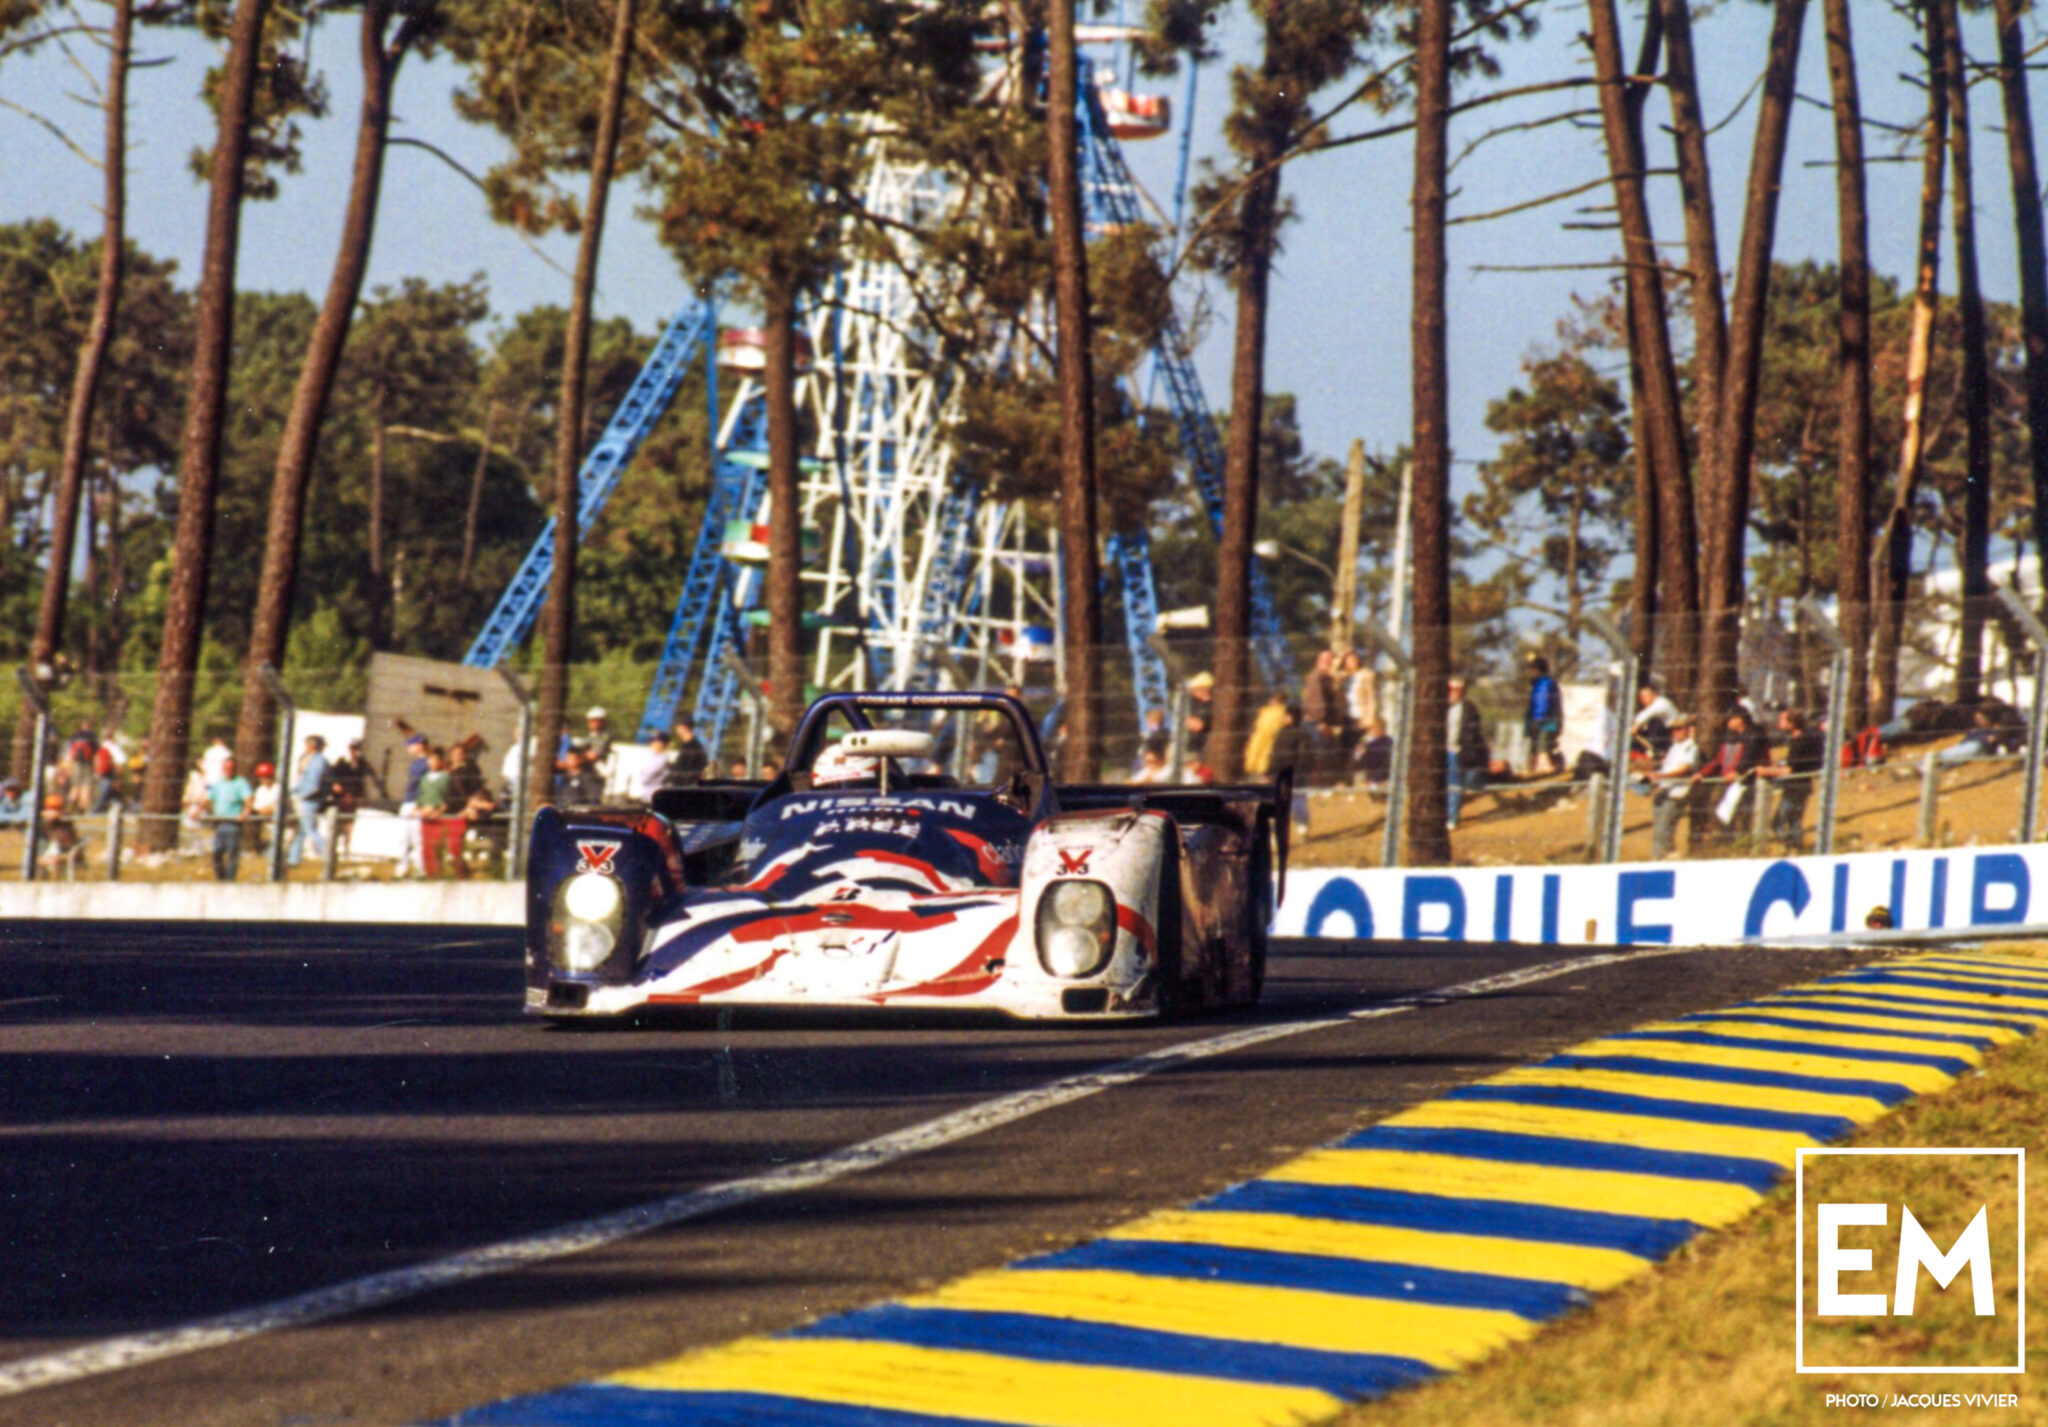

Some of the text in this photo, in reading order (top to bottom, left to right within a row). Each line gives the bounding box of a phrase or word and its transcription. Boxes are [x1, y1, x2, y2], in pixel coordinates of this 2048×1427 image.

[912, 695, 982, 704] COMPETITION
[780, 797, 977, 820] NISSAN
[1268, 870, 1676, 945] OBILE
